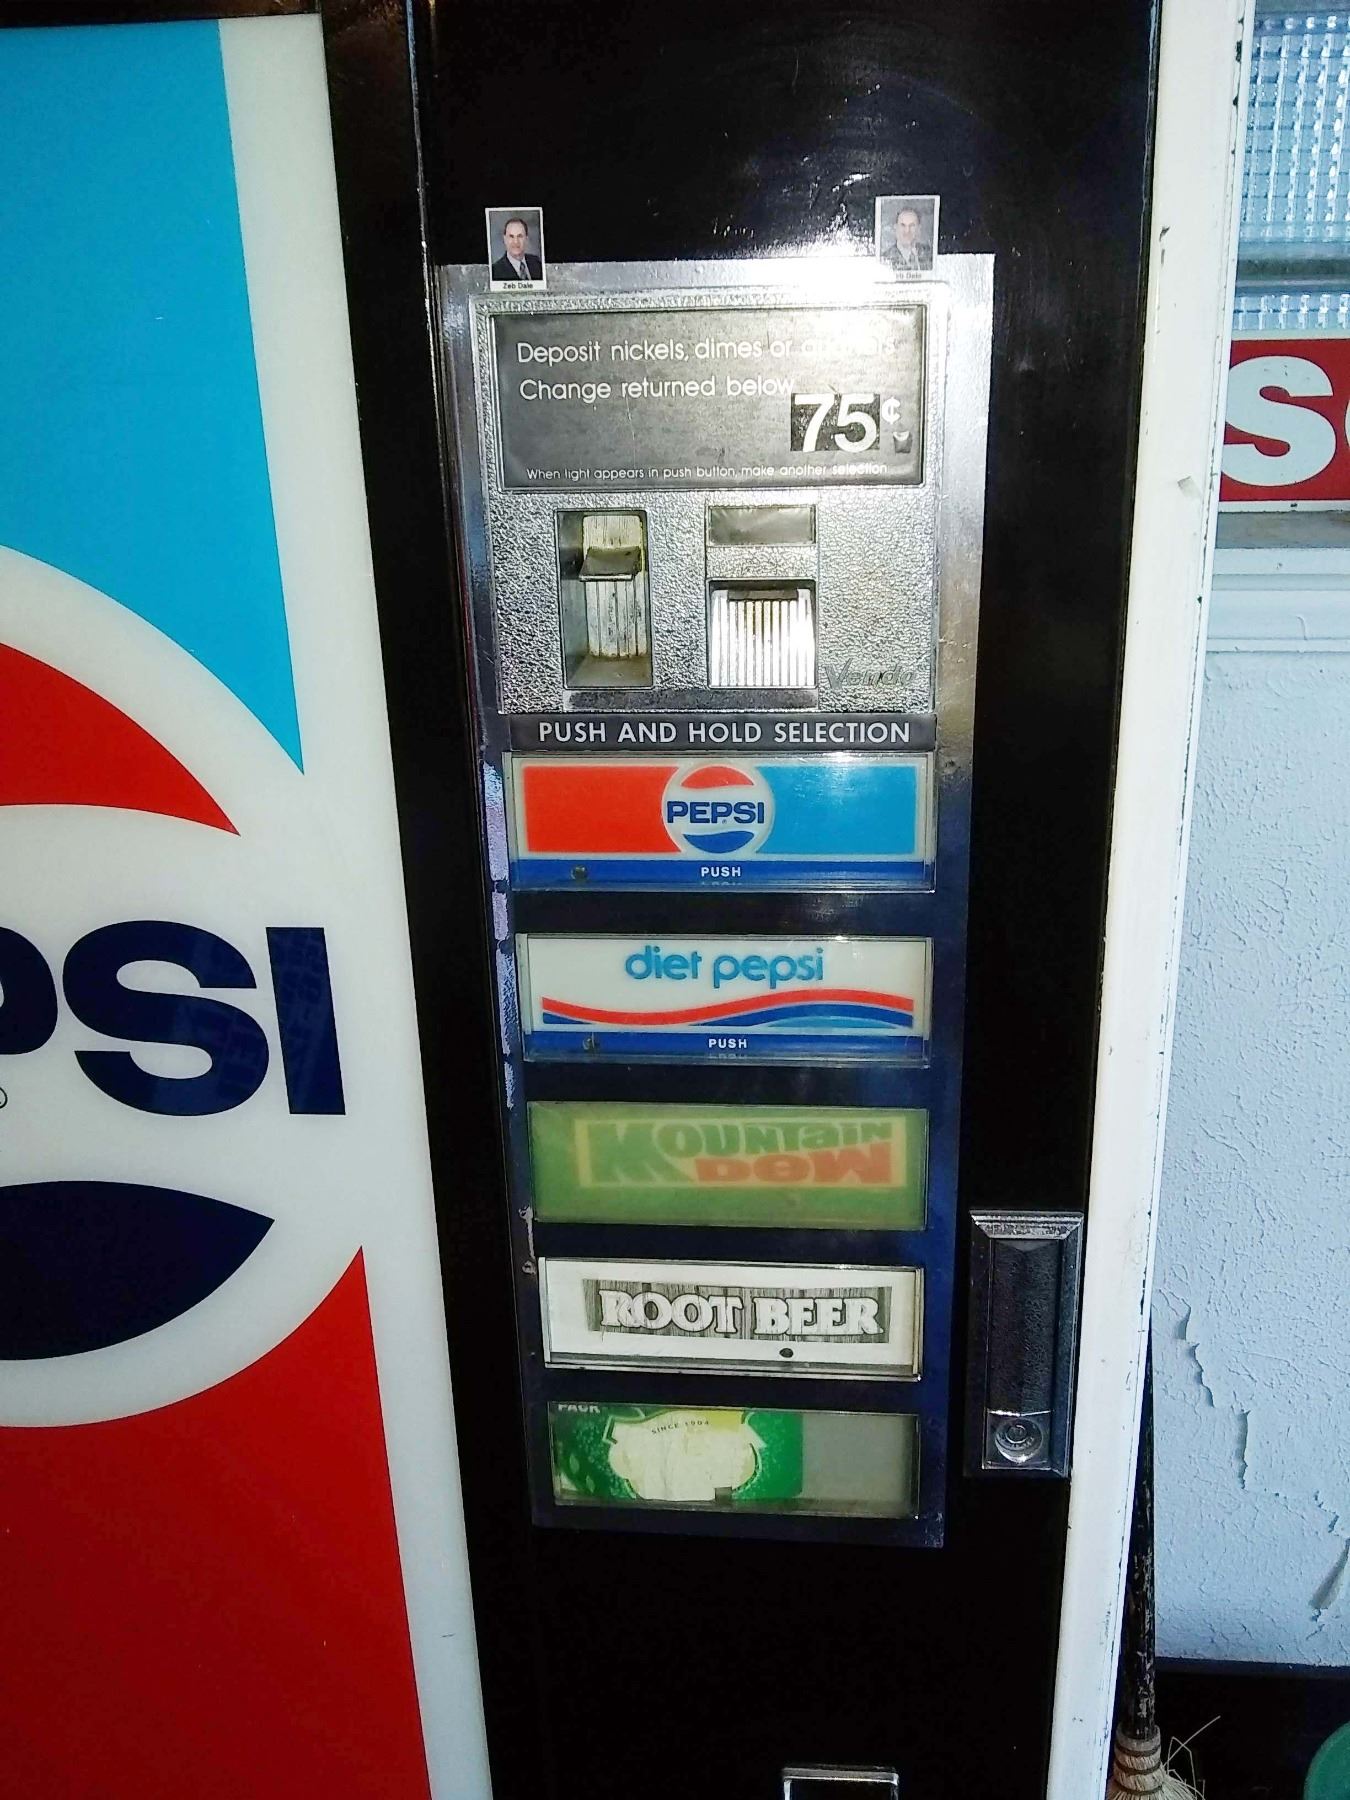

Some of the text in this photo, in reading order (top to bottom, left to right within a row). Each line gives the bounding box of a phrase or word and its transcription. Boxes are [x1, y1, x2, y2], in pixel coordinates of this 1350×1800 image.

[517, 340, 600, 367] Deposit
[611, 338, 689, 362] nickels,
[694, 337, 763, 360] dimes
[769, 340, 793, 358] or
[519, 374, 795, 404] Change returned below
[1220, 355, 1350, 487] S
[526, 461, 888, 482] When light appears in push button, make another selection
[539, 721, 911, 743] PUSH AND HOLD SELECTION
[666, 800, 765, 824] PEPSI
[701, 866, 741, 877] PUSH
[625, 945, 824, 989] diet pepsi
[708, 1038, 747, 1049] PUSH
[599, 1288, 884, 1336] ROOT BEER
[651, 1422, 679, 1434] SINCE
